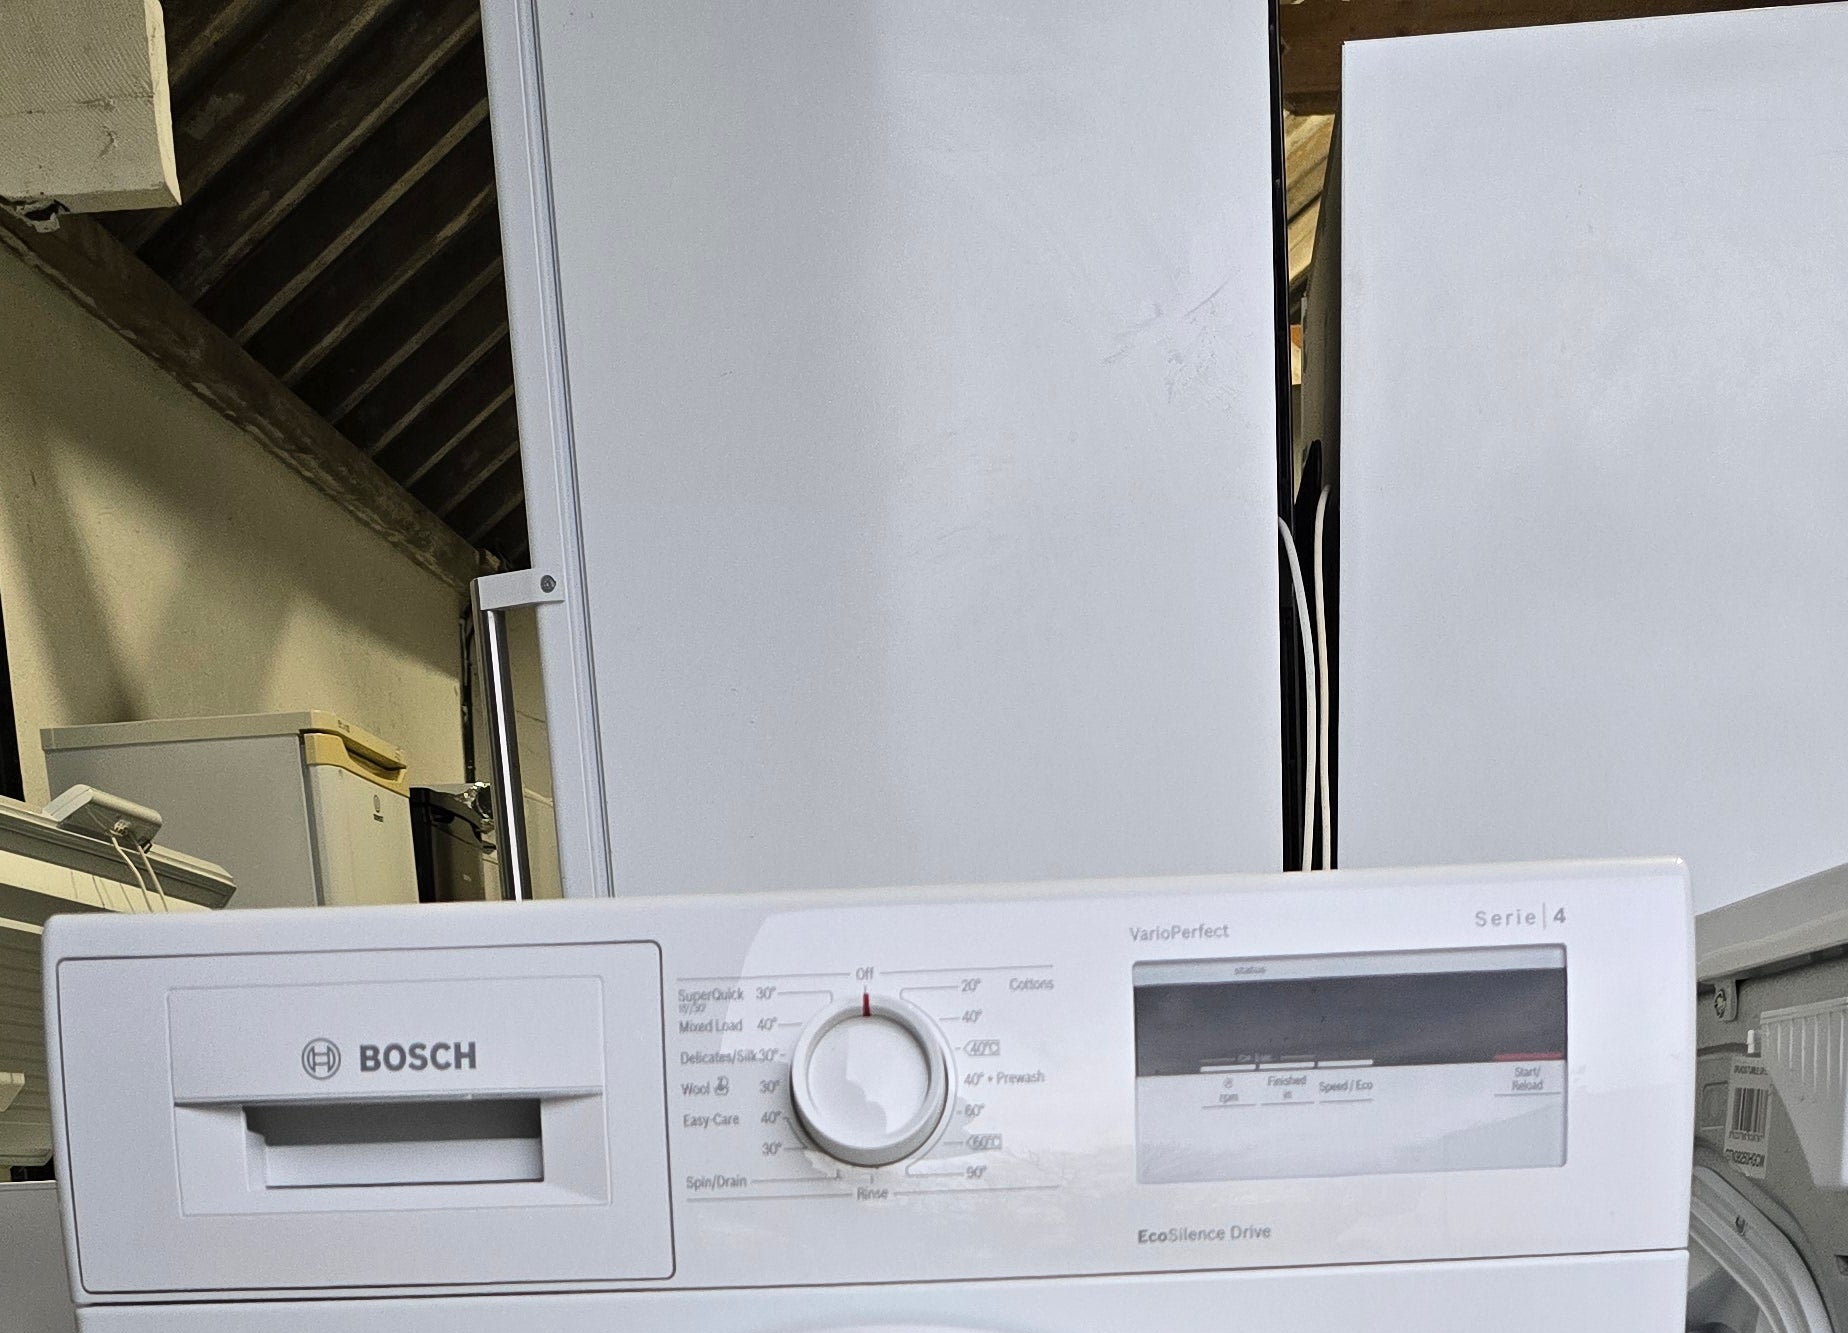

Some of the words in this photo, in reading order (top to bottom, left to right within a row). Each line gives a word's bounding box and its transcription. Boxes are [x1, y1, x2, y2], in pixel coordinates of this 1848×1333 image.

[1475, 908, 1537, 928] Serie
[1553, 907, 1567, 924] 4
[1129, 923, 1230, 941] VarioPerfect
[856, 966, 874, 981] Off
[961, 978, 981, 992] 20°
[1008, 977, 1054, 991] Cottons
[678, 987, 744, 1004] SuperQuick
[755, 986, 776, 1000] 30°
[962, 1009, 983, 1023] 40°
[679, 1020, 714, 1033] Mixed
[715, 1019, 743, 1032] Load
[757, 1016, 778, 1031] 40°
[359, 1041, 477, 1073] BOSCH
[680, 1049, 757, 1065] Delicates/Silk
[996, 1069, 1046, 1085] Prewash
[1267, 1076, 1307, 1087] Finished
[681, 1081, 710, 1096] Wool
[1319, 1080, 1349, 1093] Speed
[1356, 1079, 1373, 1091] Eco
[1511, 1080, 1544, 1092] Reload
[683, 1113, 710, 1128] Easy
[712, 1112, 740, 1126] Care
[686, 1173, 748, 1191] Spin/Drain
[857, 1186, 889, 1201] Rinse
[1137, 1226, 1226, 1244] EcoSilence
[1230, 1223, 1273, 1240] Drive
